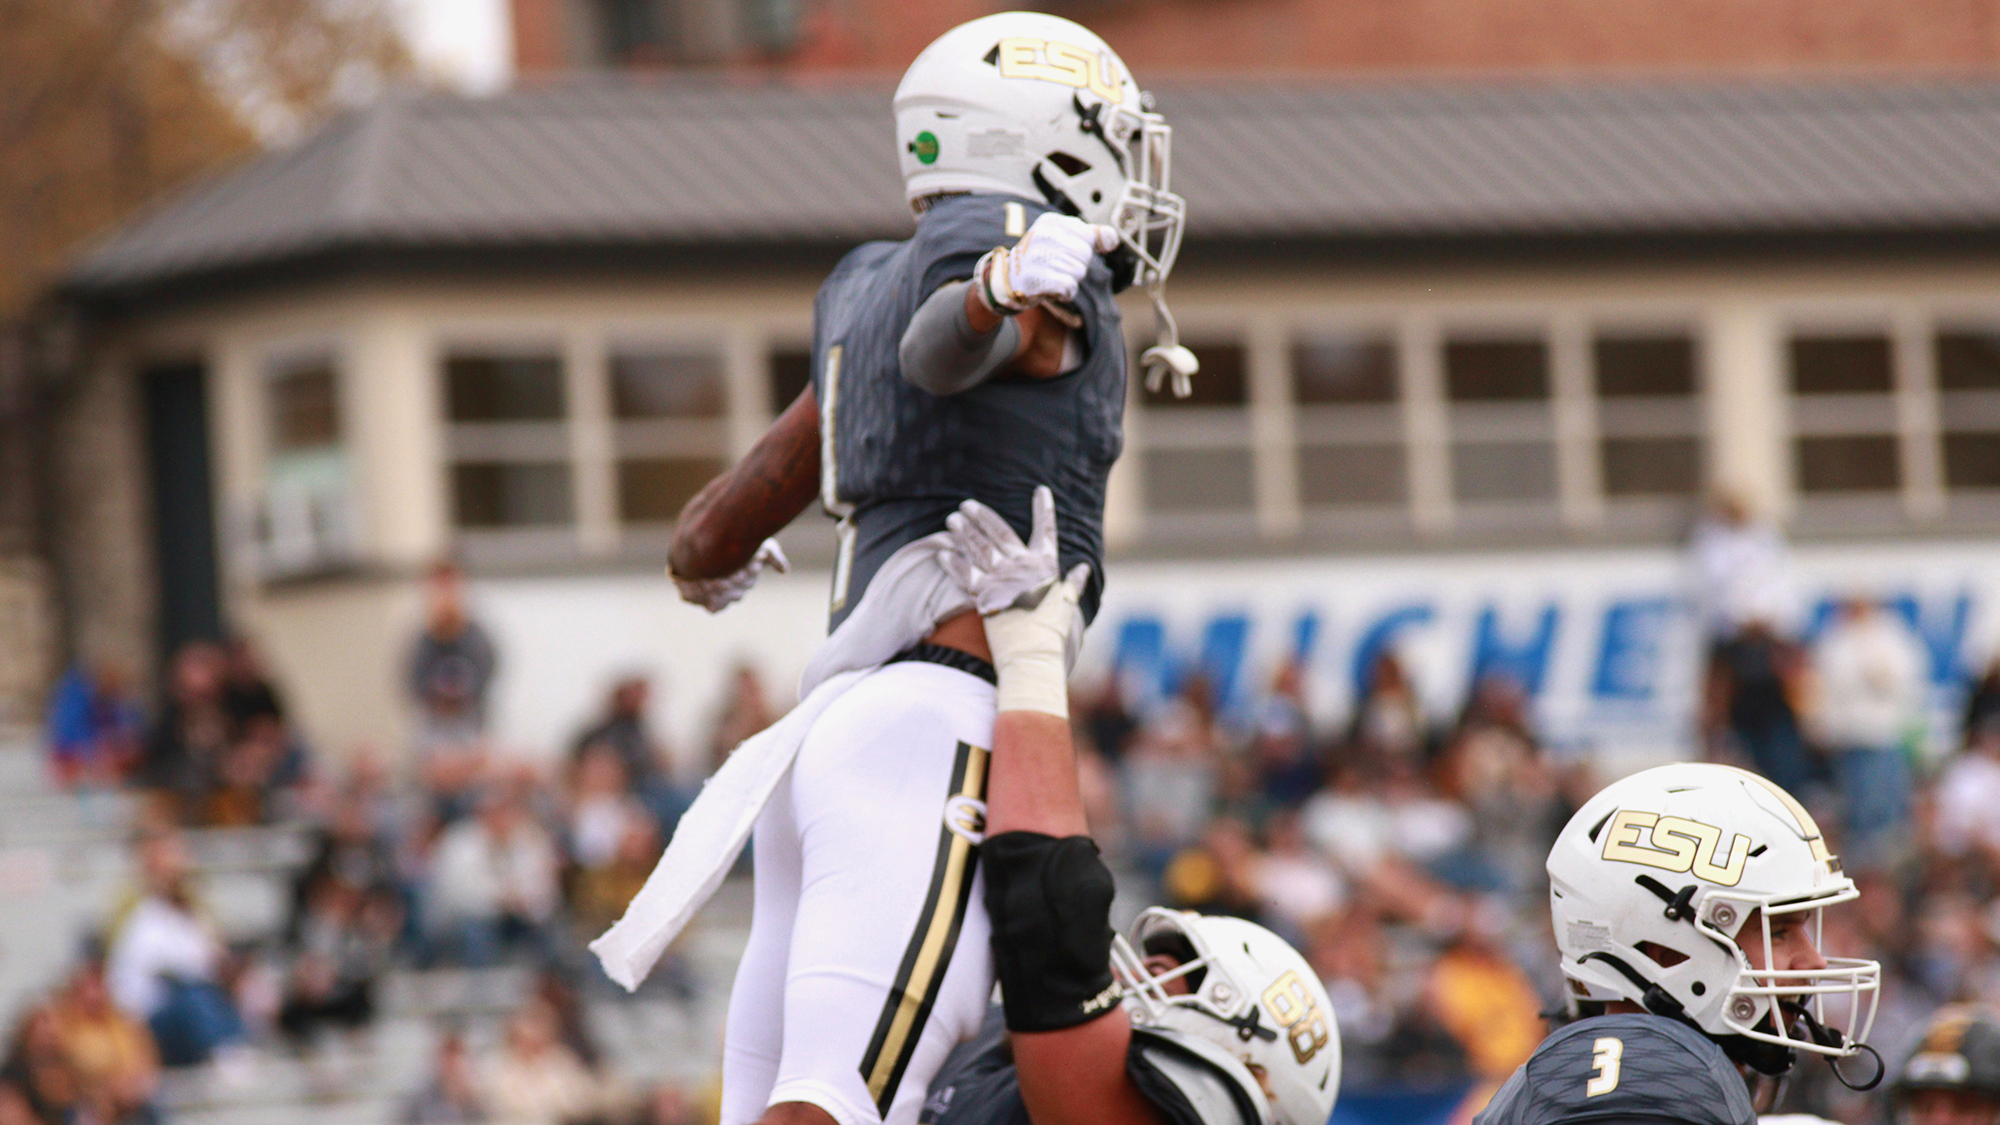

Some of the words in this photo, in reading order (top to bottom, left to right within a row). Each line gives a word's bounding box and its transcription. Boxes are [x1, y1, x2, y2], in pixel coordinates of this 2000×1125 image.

[999, 37, 1123, 104] ESU
[1602, 809, 1752, 887] ESU
[1262, 969, 1328, 1065] 68
[1587, 1037, 1624, 1097] 3
